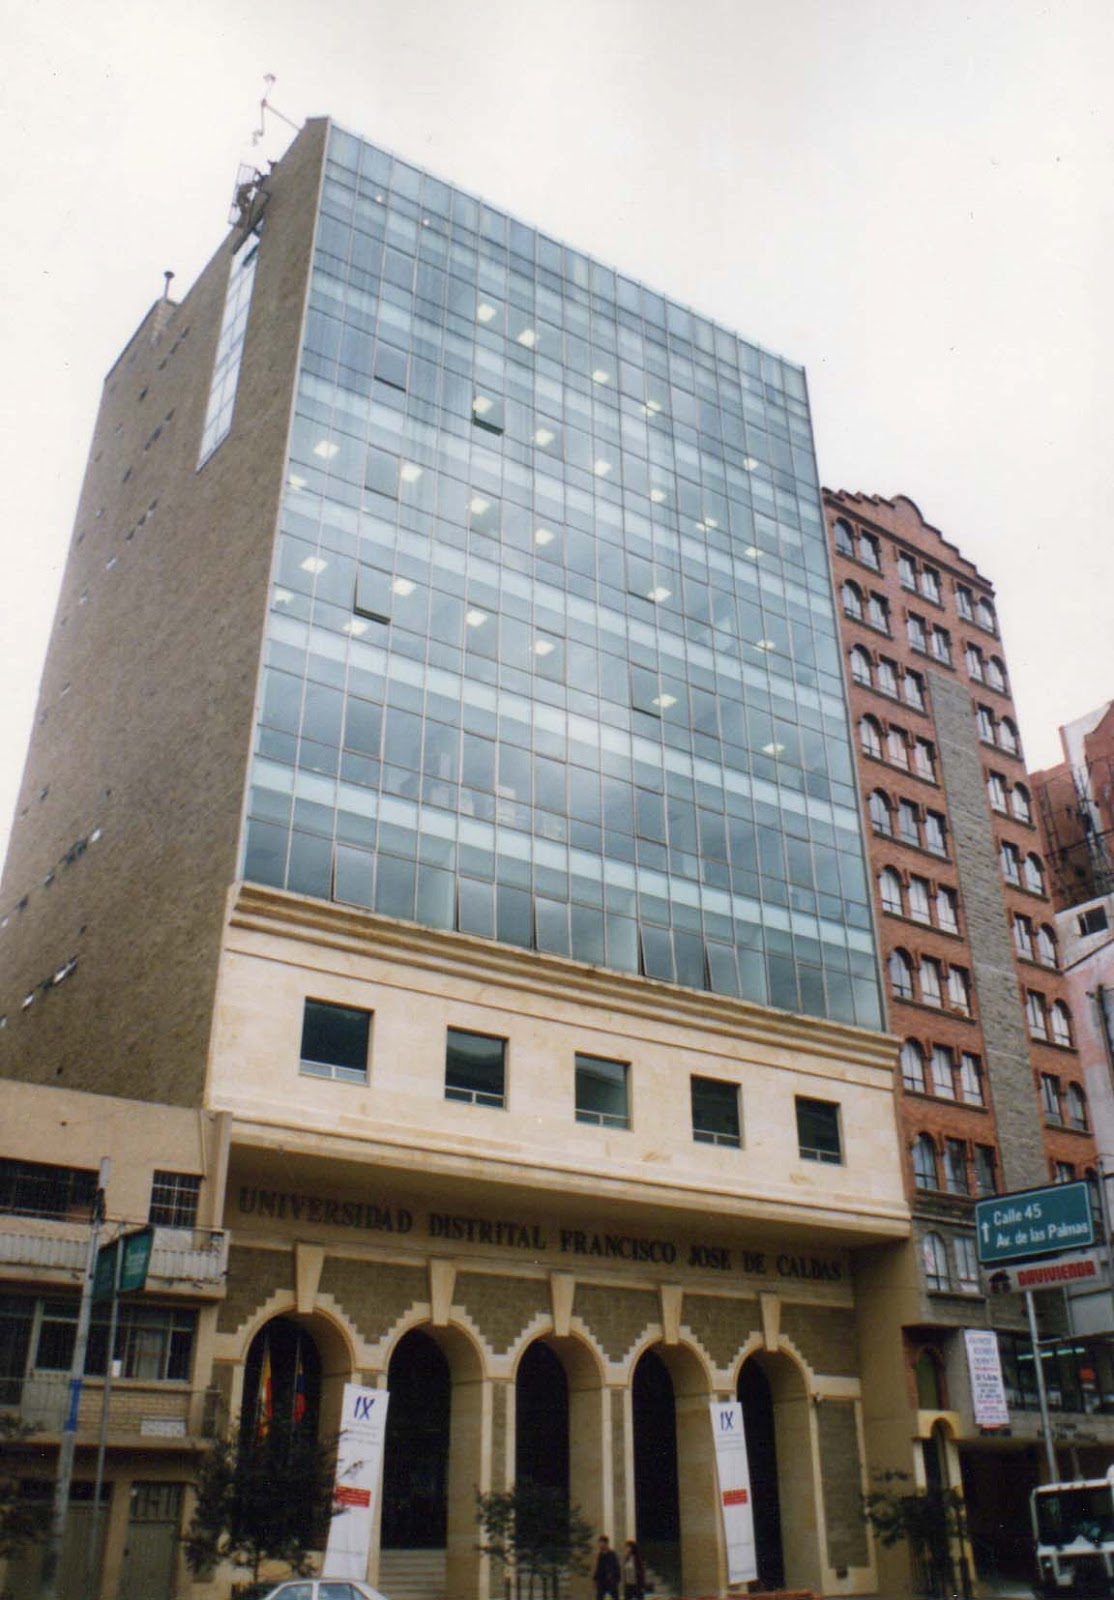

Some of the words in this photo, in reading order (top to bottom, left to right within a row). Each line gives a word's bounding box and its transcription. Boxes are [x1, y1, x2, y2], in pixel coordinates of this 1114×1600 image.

[994, 1207, 1022, 1226] Calle
[1024, 1203, 1042, 1219] 45
[239, 1187, 412, 1234] UNIVERSIDAD
[429, 1213, 547, 1250] DISTRITAL
[560, 1230, 676, 1265] FRANCISCO
[689, 1245, 732, 1270] JOSE
[742, 1251, 766, 1274] DE
[777, 1255, 842, 1280] CALDAS
[1015, 1230, 1028, 1245] de
[1030, 1228, 1045, 1241] las
[1048, 1222, 1088, 1239] Palmas
[354, 1396, 375, 1420] IX
[720, 1411, 734, 1430] IX
